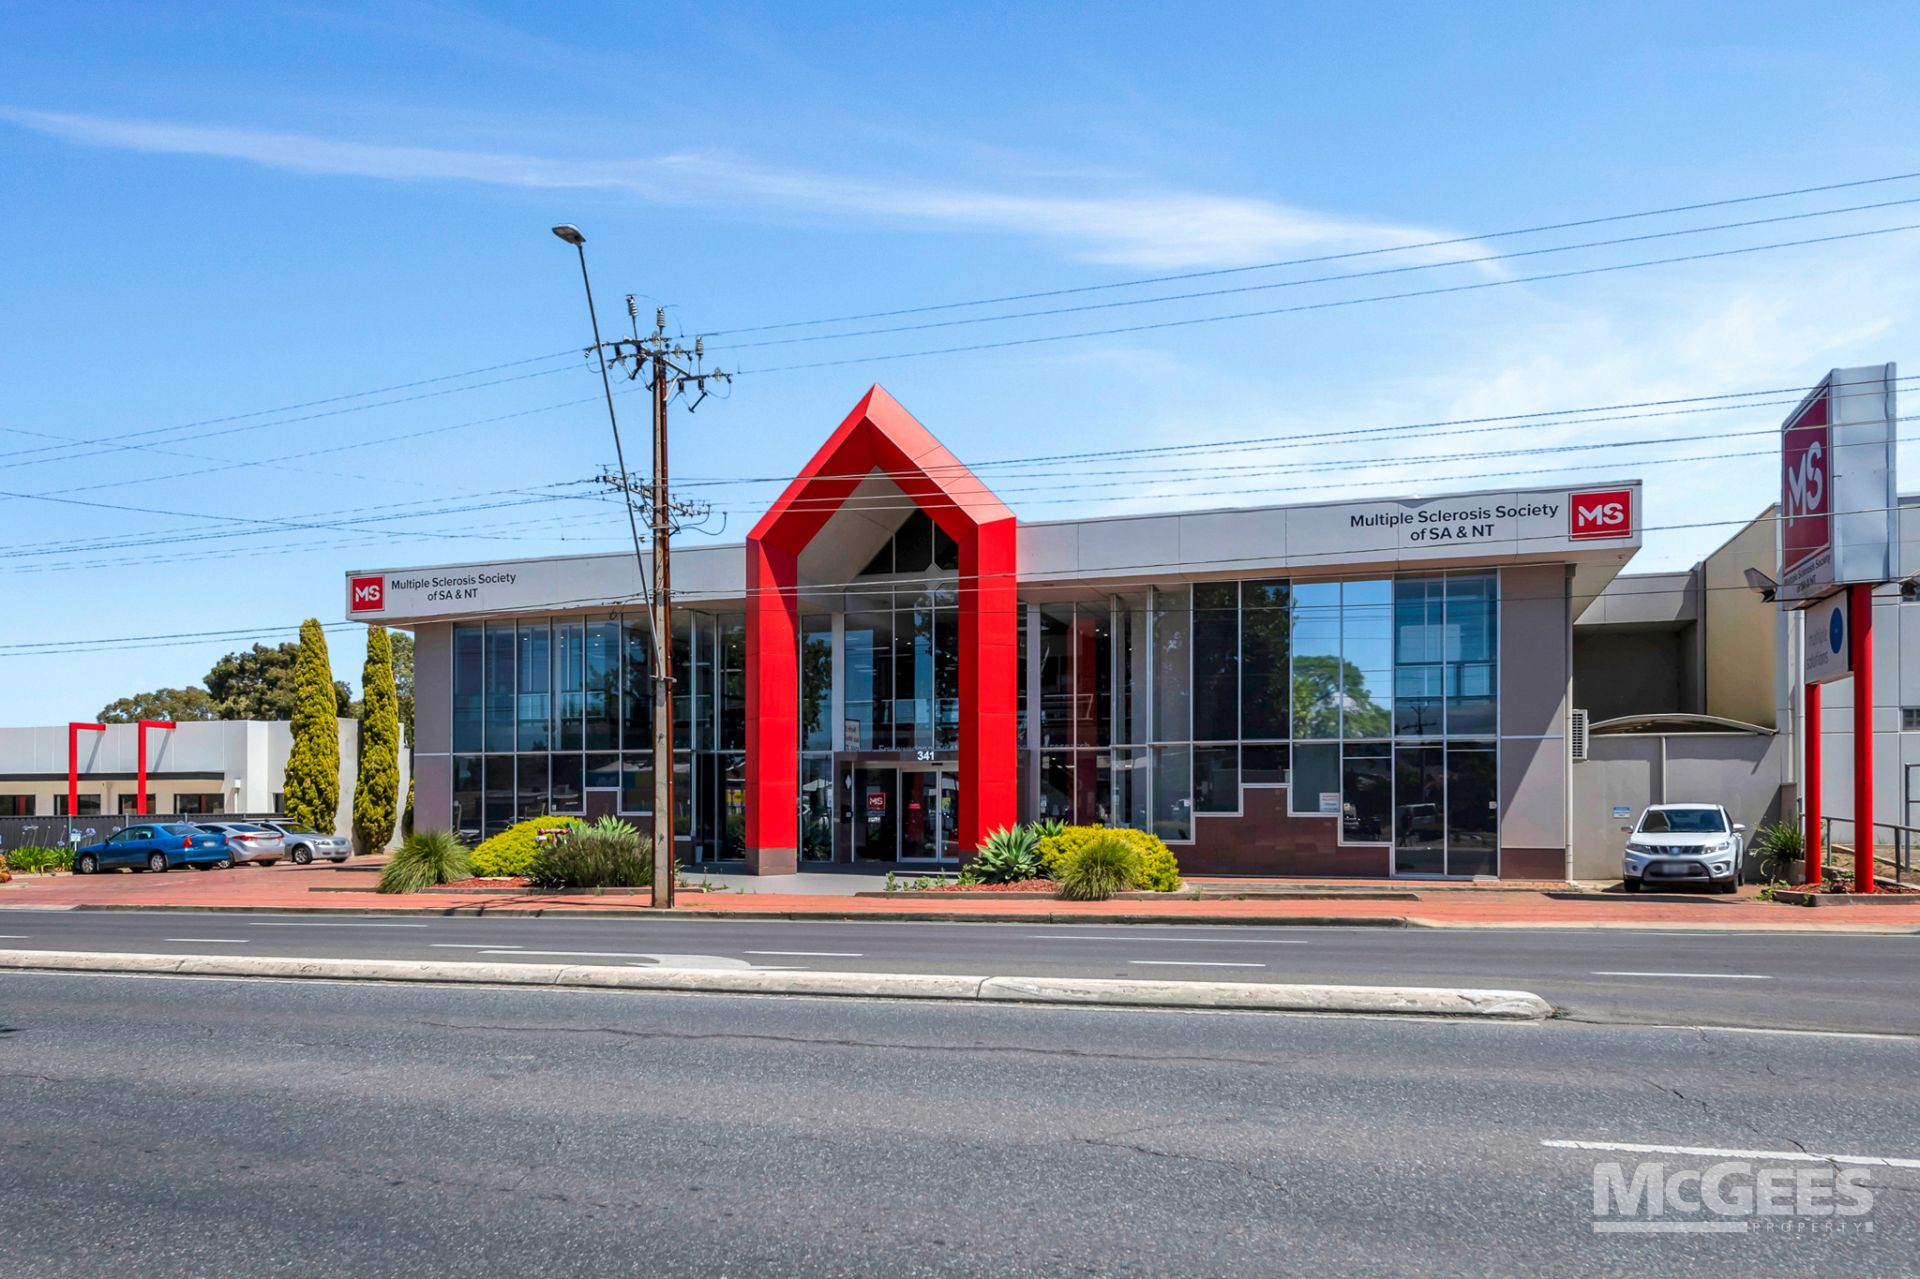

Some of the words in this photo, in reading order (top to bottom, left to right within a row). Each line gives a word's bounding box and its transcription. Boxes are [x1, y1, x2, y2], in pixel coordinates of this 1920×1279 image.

[1788, 441, 1823, 528] MS
[1350, 512, 1414, 528] Multiple
[1418, 507, 1491, 523] Sclerosis
[1495, 504, 1559, 518] Society
[1578, 502, 1624, 526] MS
[1410, 528, 1426, 541] of
[1429, 527, 1452, 540] SA
[1456, 525, 1468, 538] &
[1472, 524, 1494, 537] NT
[391, 578, 430, 590] Multiple
[432, 575, 476, 587] Sclerosis
[478, 573, 517, 584] Society
[355, 585, 381, 602] MS
[427, 590, 438, 601] of
[438, 590, 453, 600] SA
[455, 589, 462, 599] &
[464, 588, 478, 599] NT
[917, 751, 934, 760] 341
[869, 797, 883, 805] MS
